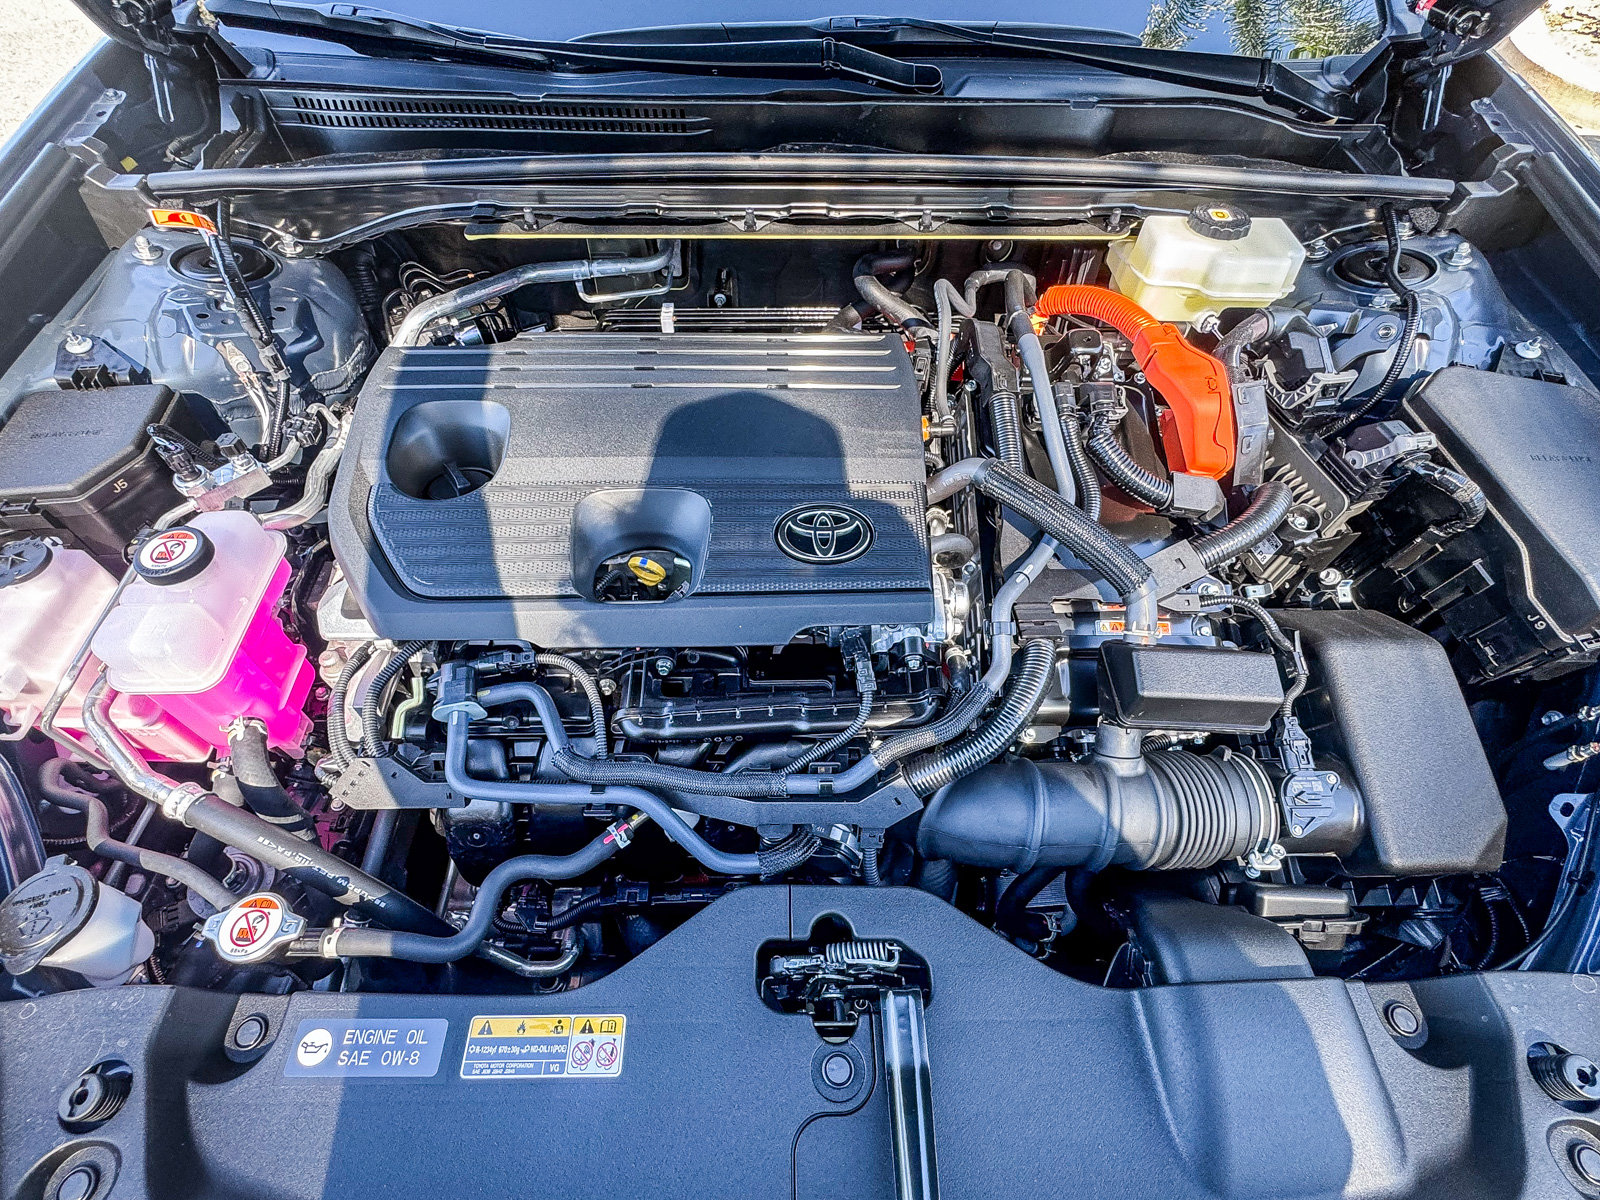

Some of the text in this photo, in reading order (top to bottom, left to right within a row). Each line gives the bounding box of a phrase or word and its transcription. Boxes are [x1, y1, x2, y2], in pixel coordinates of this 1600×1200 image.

[113, 478, 129, 494] J5
[1526, 612, 1547, 631] J9
[343, 1029, 428, 1044] ENGINE OIL
[337, 1050, 371, 1066] SAE
[549, 1063, 560, 1072] VG
